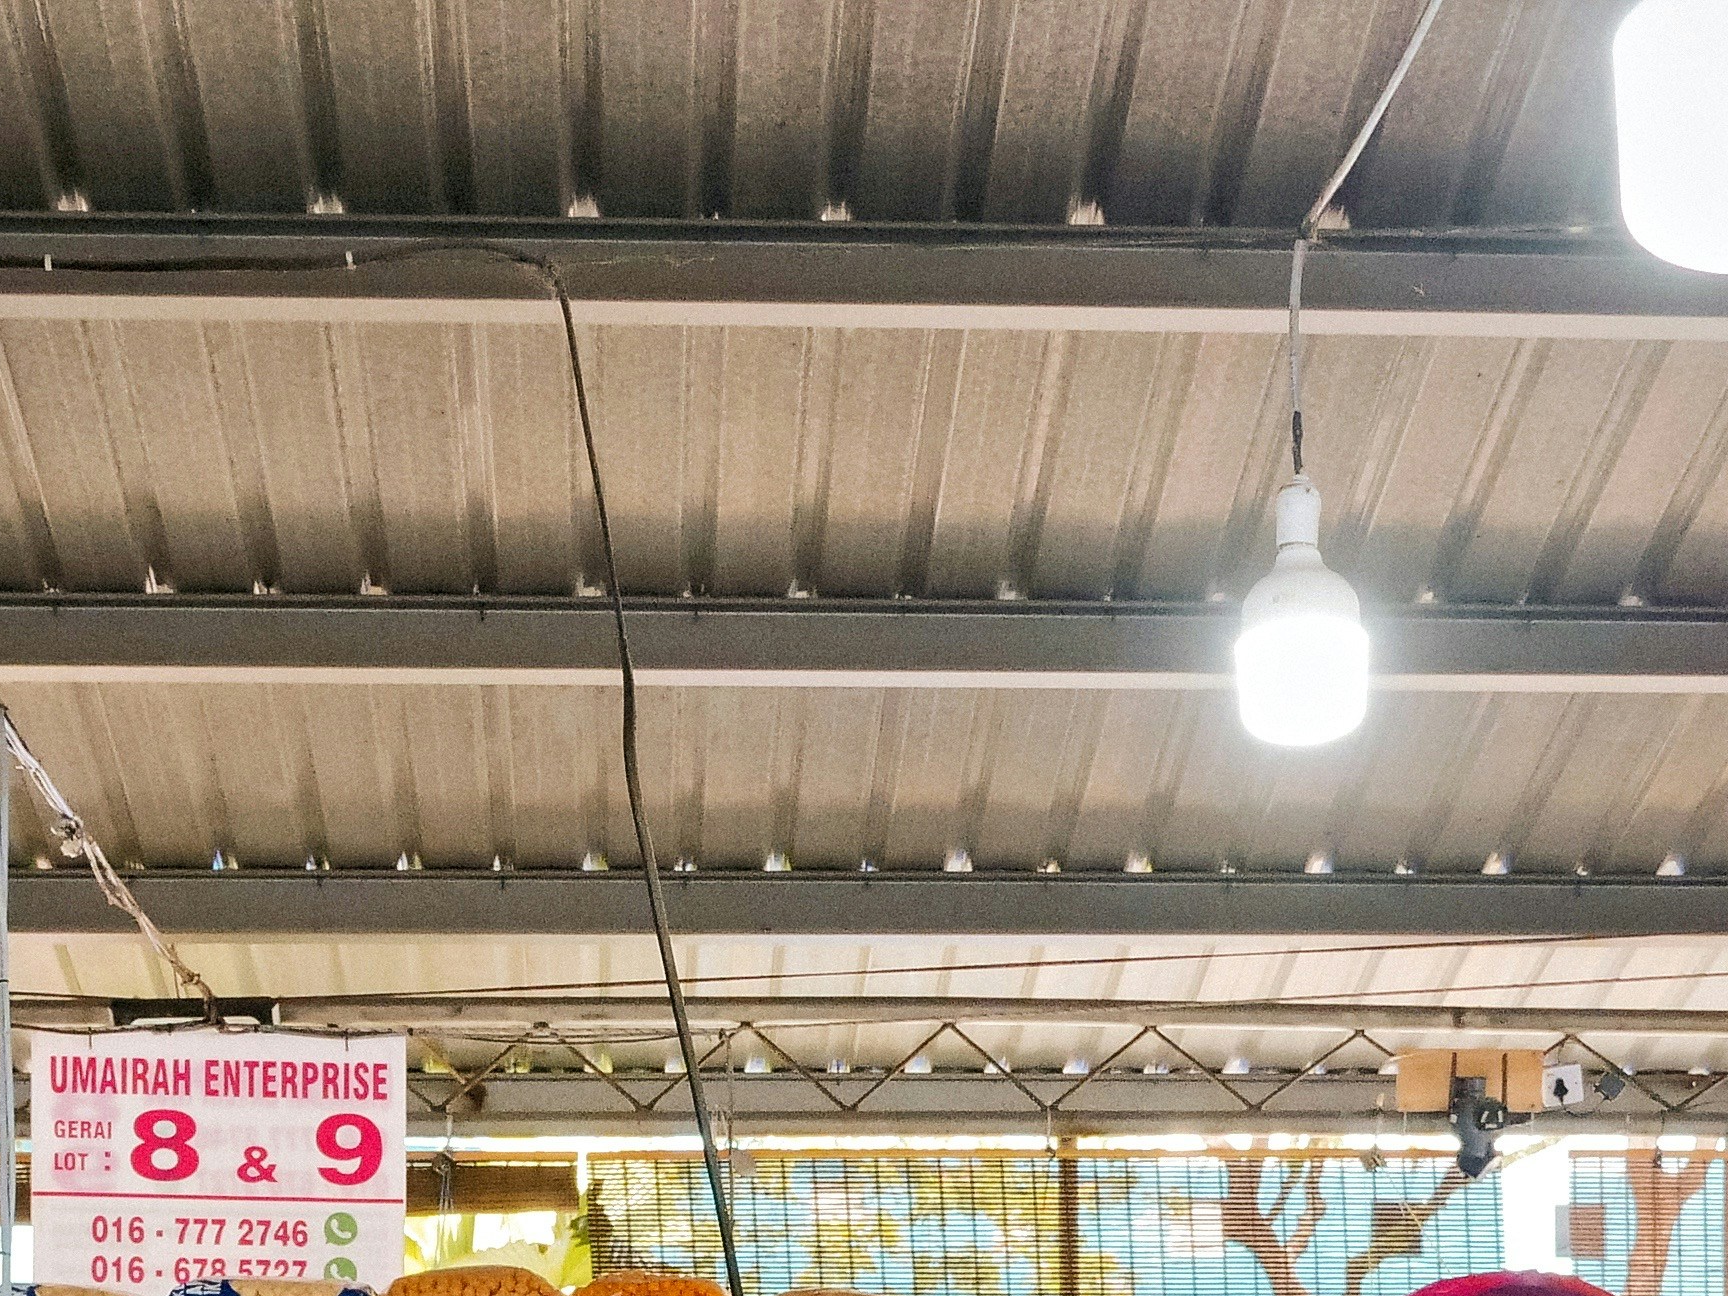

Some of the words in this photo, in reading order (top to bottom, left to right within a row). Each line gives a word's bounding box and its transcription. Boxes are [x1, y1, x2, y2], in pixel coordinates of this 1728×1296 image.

[50, 1055, 191, 1096] UMAIRAH
[204, 1059, 388, 1101] ENTERPRISE
[54, 1120, 112, 1140] GERAI
[54, 1152, 87, 1171] LOT
[130, 1108, 200, 1182] 8
[236, 1145, 278, 1184] &
[315, 1113, 382, 1186] 9
[91, 1215, 145, 1245] 016
[175, 1218, 225, 1246] 777
[238, 1219, 309, 1248] 2746
[90, 1255, 145, 1284] 016
[174, 1257, 225, 1286] 678
